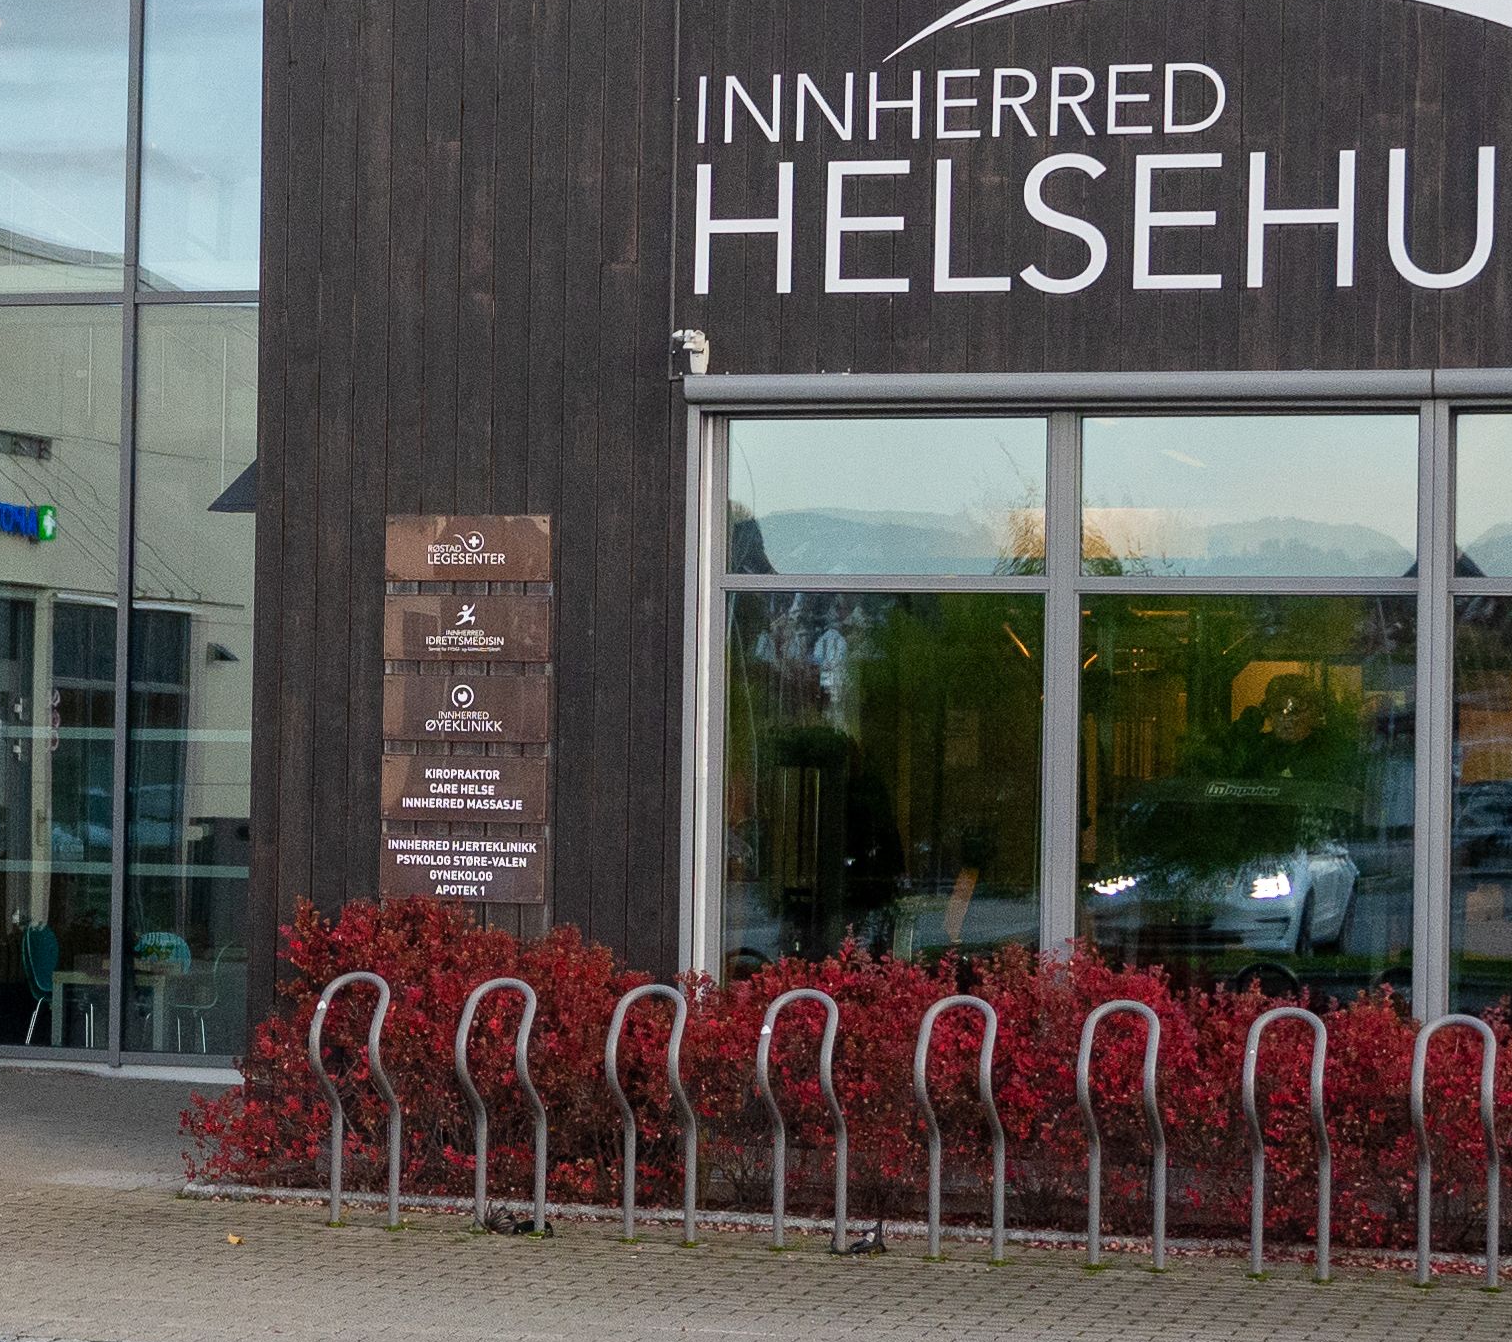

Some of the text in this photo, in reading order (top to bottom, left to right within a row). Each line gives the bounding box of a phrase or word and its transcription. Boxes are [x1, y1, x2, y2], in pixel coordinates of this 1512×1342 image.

[696, 62, 1226, 145] INNHERRED
[427, 544, 462, 553] RØSTAD
[427, 553, 506, 565] LEGESENTER
[425, 635, 505, 646] IDRETTSMEDISIN
[438, 710, 490, 719] INNHERRED
[425, 719, 503, 732] ØYEKLINIKK
[424, 768, 500, 780] KIROPRAKTOR
[429, 783, 495, 796] CARE HELSE
[402, 797, 523, 811] INNHERRED MASSASJE
[387, 839, 538, 854] INNHERRED HJERTEKLINIKK
[396, 854, 527, 868] PSYKOLOG STØRE-VALEN
[429, 869, 493, 881] GYNEKOLOG
[435, 884, 486, 896] APOTEK 1
